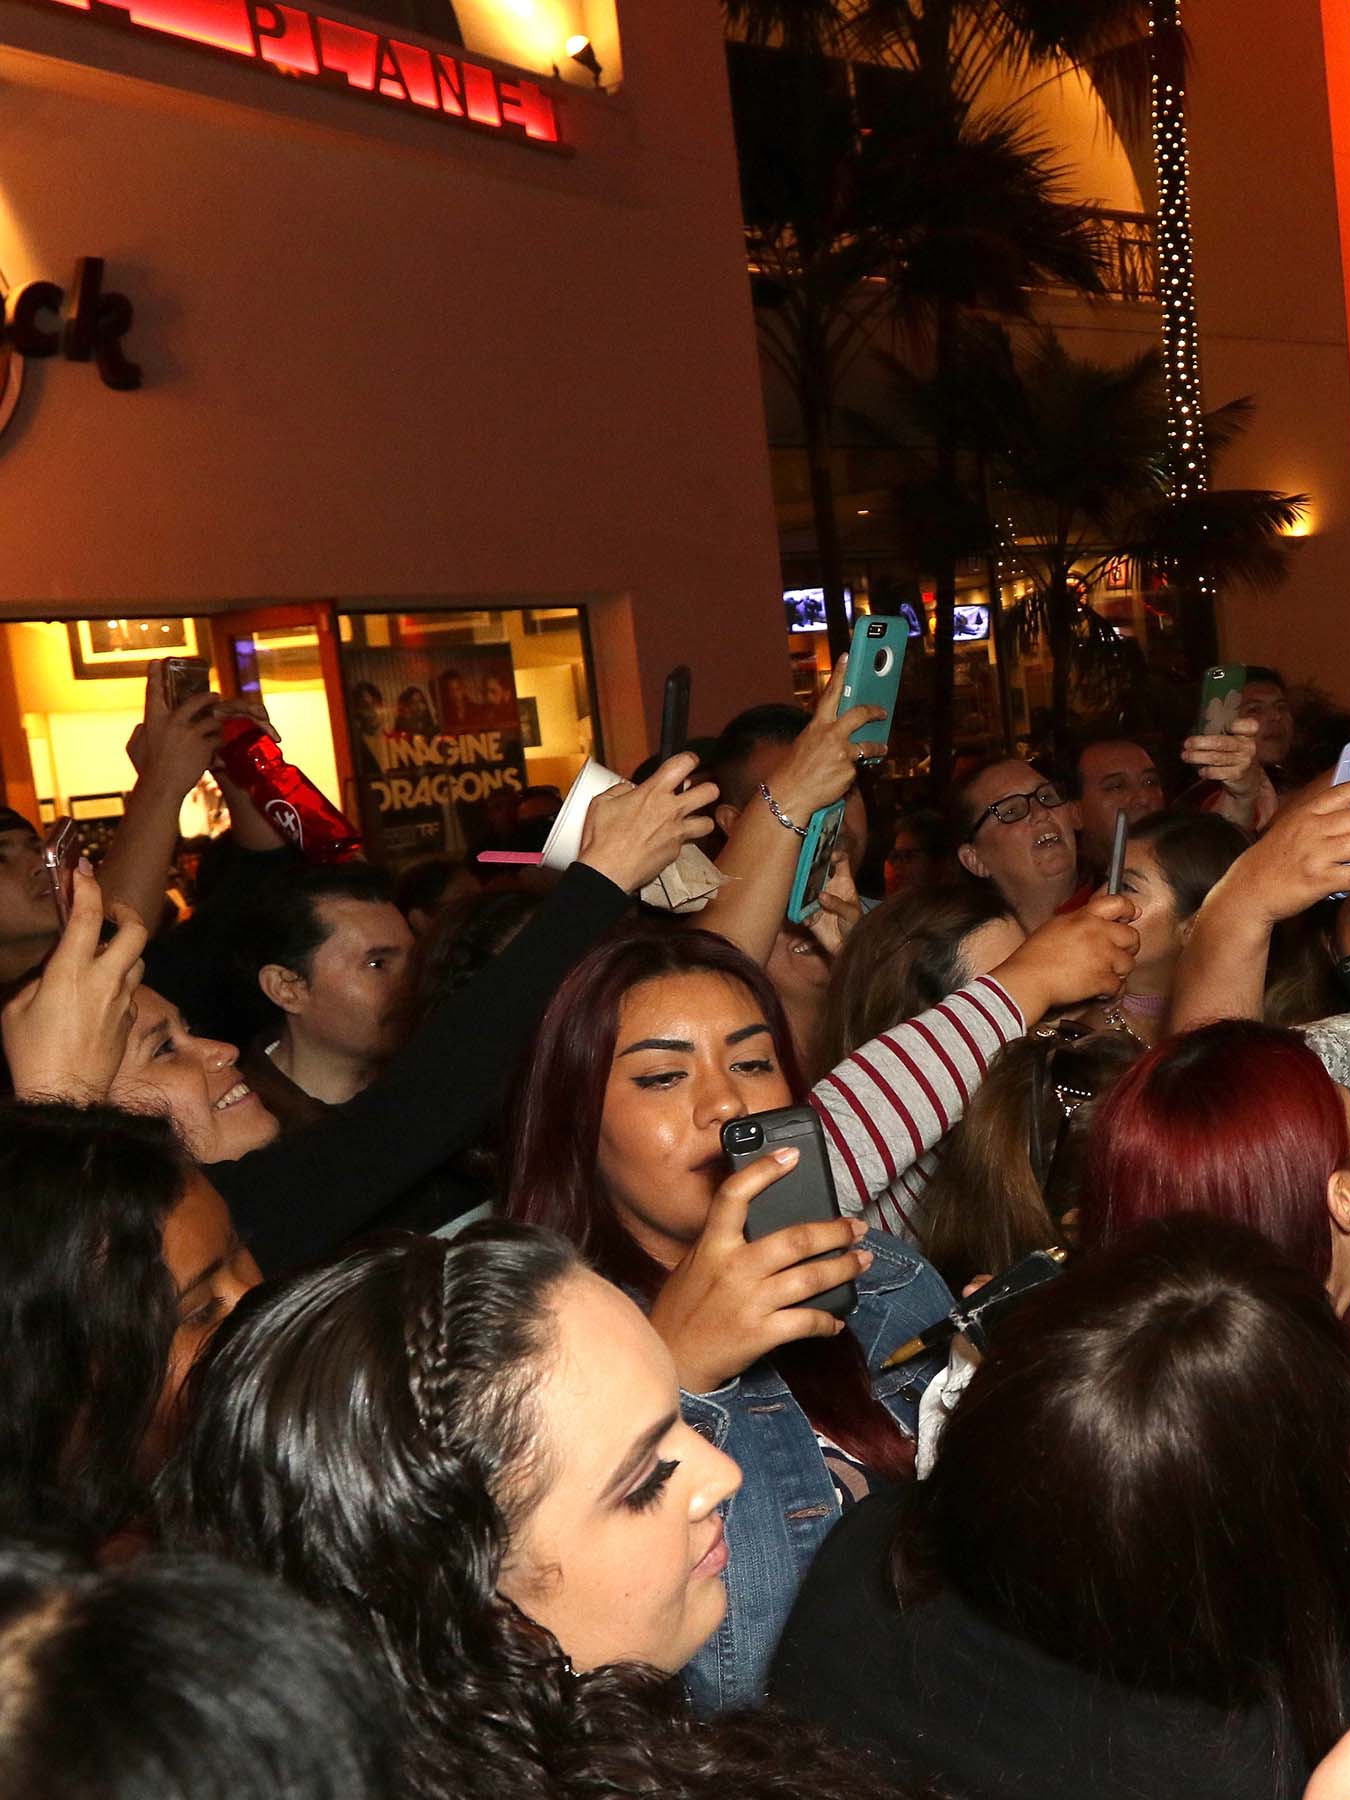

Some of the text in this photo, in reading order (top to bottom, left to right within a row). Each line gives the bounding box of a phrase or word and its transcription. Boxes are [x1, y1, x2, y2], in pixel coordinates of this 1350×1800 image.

[252, 2, 570, 146] PLANET
[0, 256, 143, 391] ck
[364, 731, 504, 776] IMAGINE
[370, 767, 523, 812] DRAGONS
